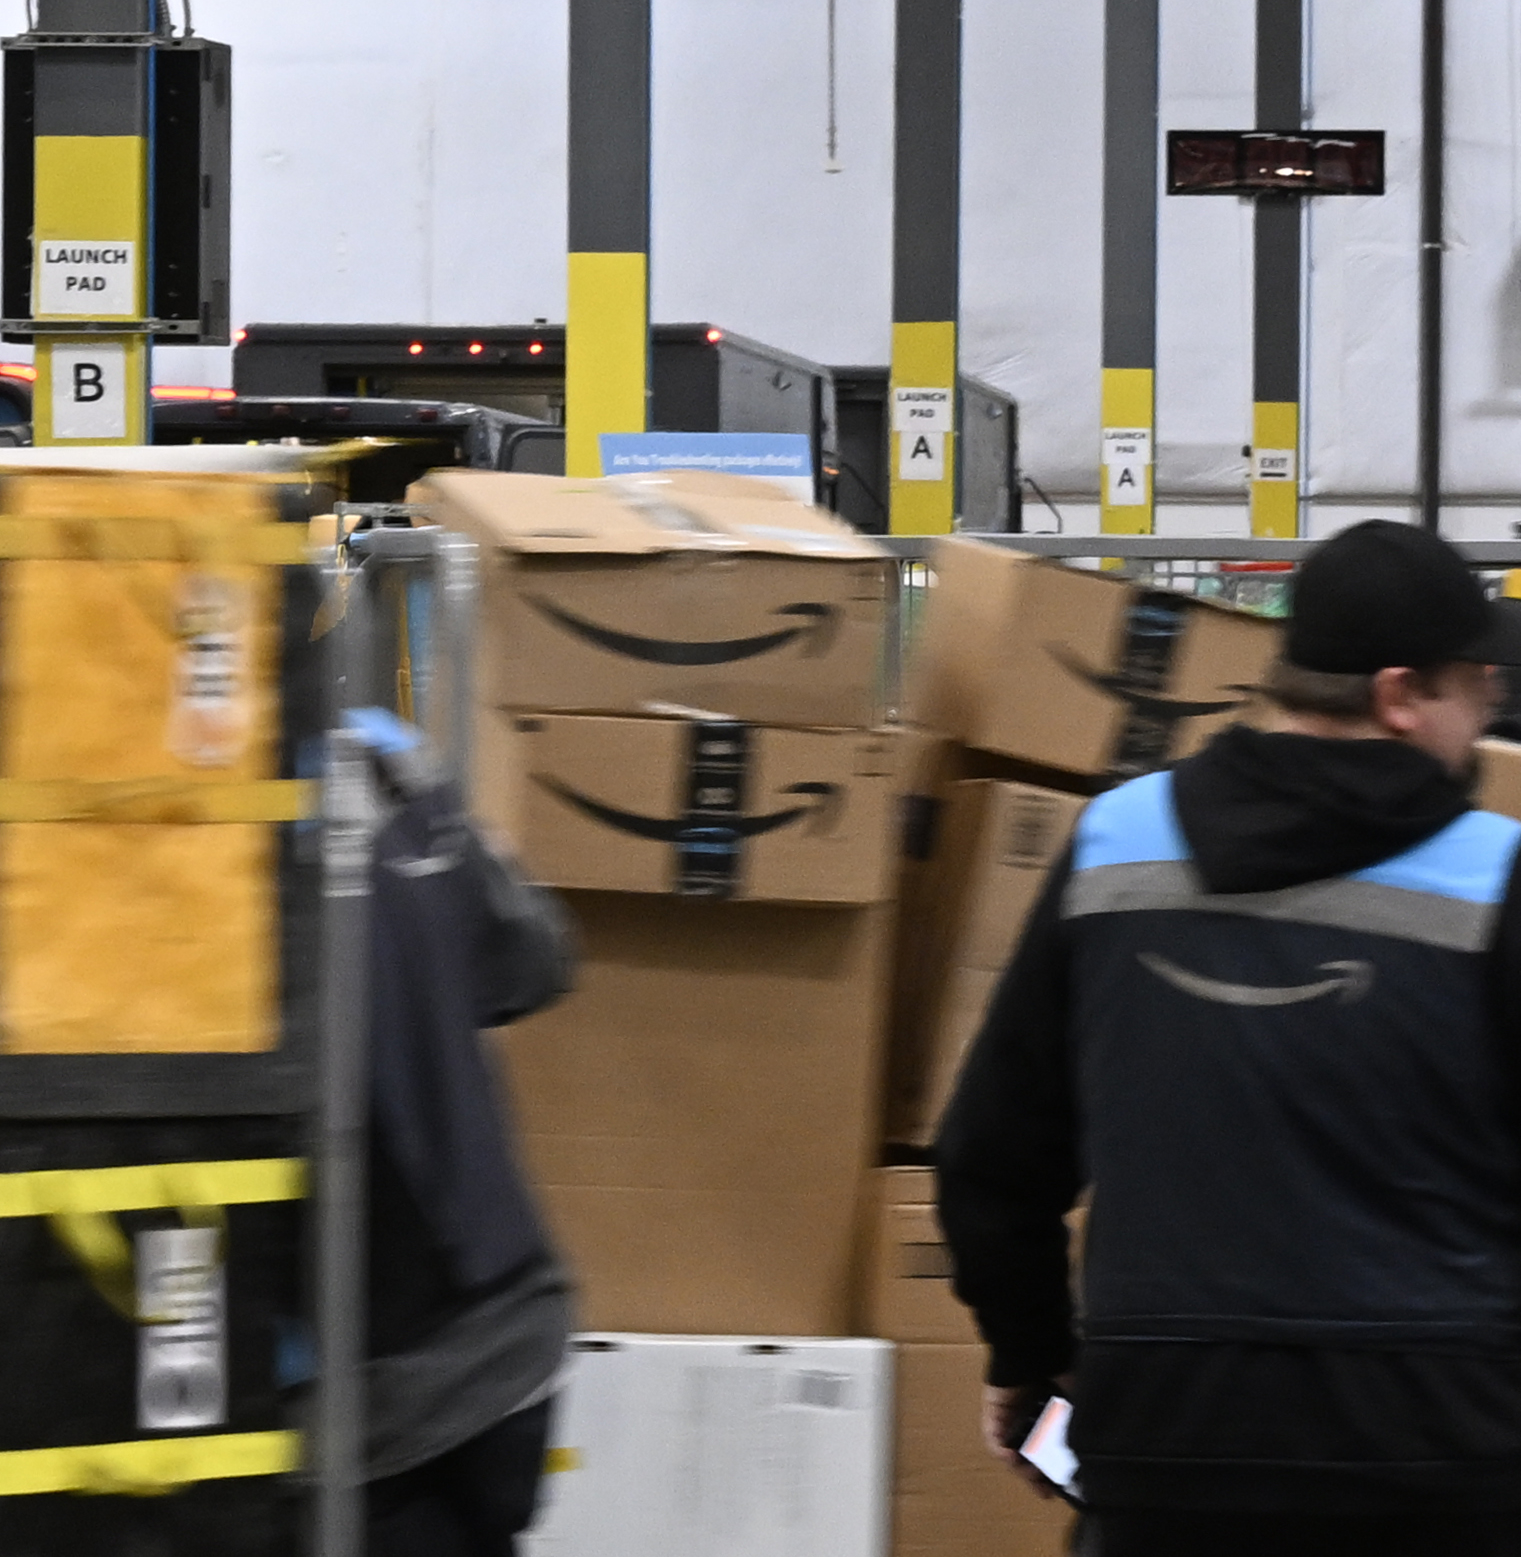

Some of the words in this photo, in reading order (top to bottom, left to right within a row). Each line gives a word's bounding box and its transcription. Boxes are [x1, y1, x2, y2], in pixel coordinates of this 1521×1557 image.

[45, 248, 128, 264] LAUNCH
[65, 276, 106, 291] PAD
[73, 362, 105, 403] B
[910, 435, 933, 459] A
[1117, 467, 1136, 488] A
